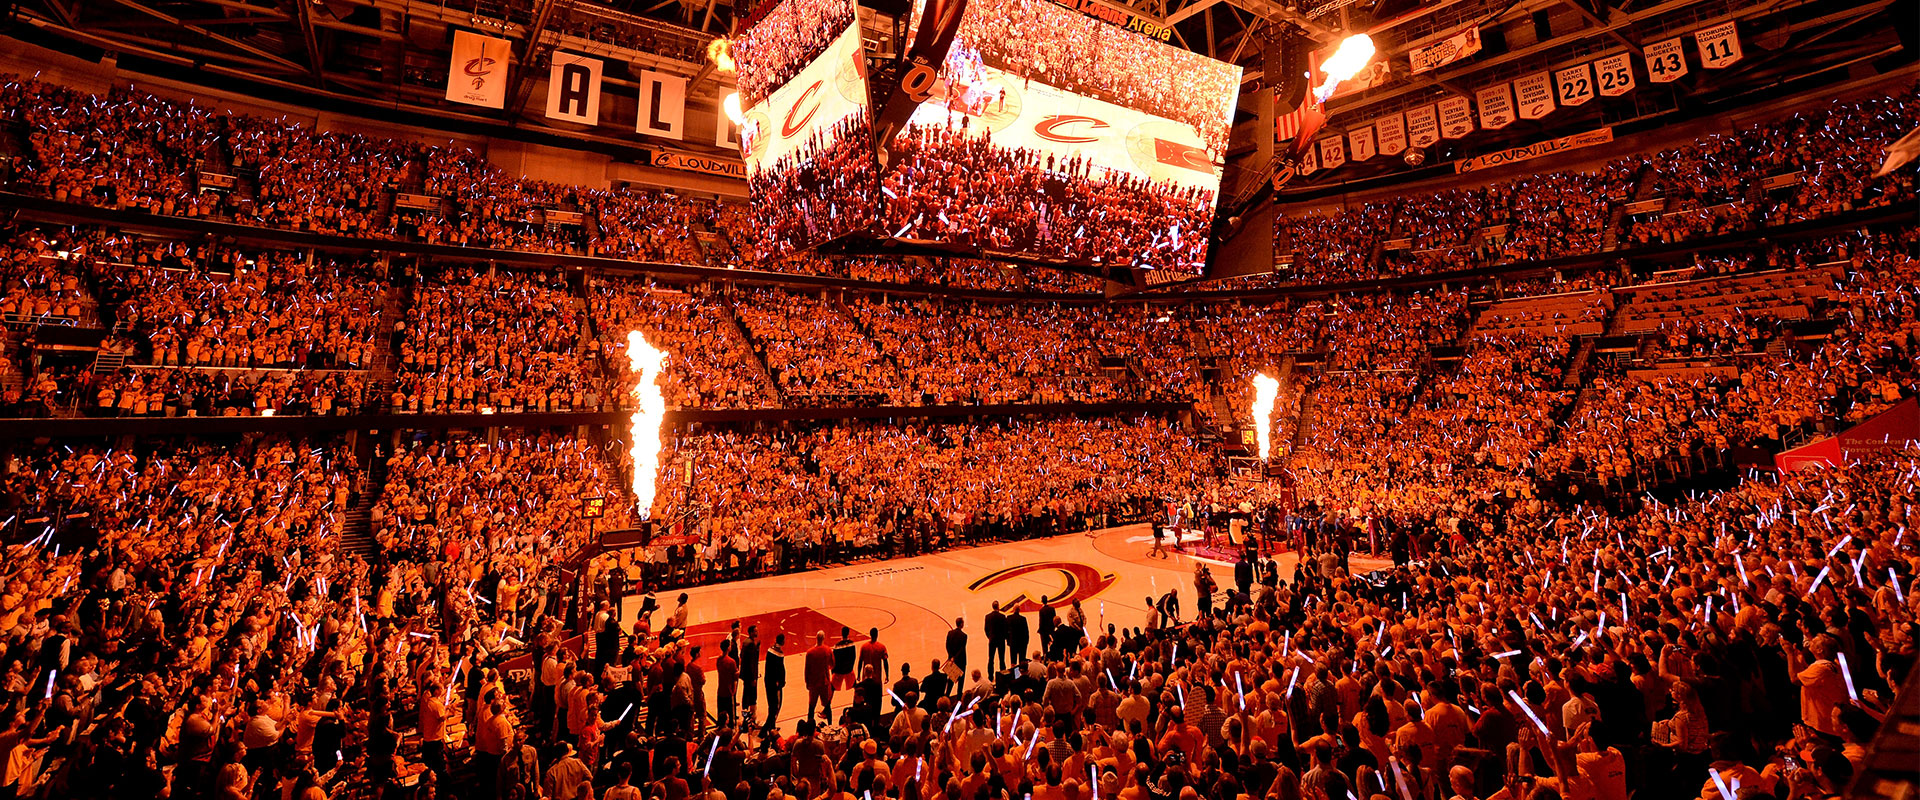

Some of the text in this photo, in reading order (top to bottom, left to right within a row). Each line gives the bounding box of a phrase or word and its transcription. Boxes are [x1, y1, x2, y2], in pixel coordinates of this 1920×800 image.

[1080, 0, 1172, 41] Loans Arena
[1698, 24, 1733, 38] ZYDRUNAS
[1646, 46, 1681, 58] DAUGHERTY
[1653, 43, 1672, 51] BRAD
[1706, 39, 1733, 61] 11
[1412, 44, 1457, 71] HEROES
[1602, 57, 1622, 66] MARK
[1603, 63, 1623, 71] PRICE
[1652, 53, 1681, 75] 43
[1562, 68, 1583, 77] LARRY
[1563, 73, 1584, 81] NANCE
[902, 62, 936, 103] Q
[1601, 67, 1630, 90] 25
[558, 63, 591, 117] A
[1522, 84, 1544, 94] CENTRAL
[1523, 90, 1545, 99] DIVISION
[1562, 78, 1590, 100] 22
[1484, 95, 1505, 104] CENTRAL
[1520, 95, 1550, 106] CHAMPIONS
[649, 80, 671, 132] L
[1444, 106, 1465, 115] CENTRAL
[1485, 101, 1506, 110] DIVISION
[1446, 112, 1465, 120] DIVISION
[1482, 106, 1510, 117] CHAMPIONS
[1412, 116, 1431, 125] EASTERN
[1444, 117, 1469, 127] CHAMPIONS
[1382, 124, 1400, 132] CENTRAL
[1357, 139, 1366, 155] 7
[1324, 146, 1342, 163] 42
